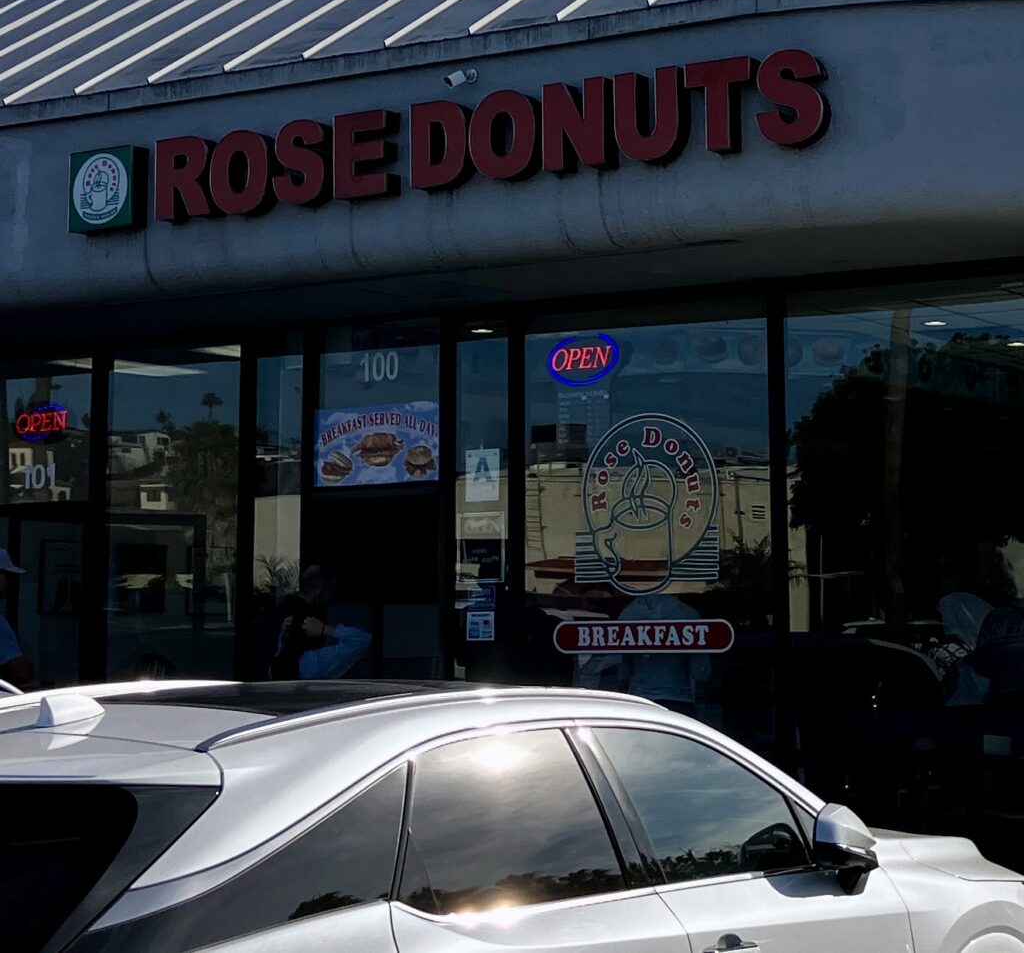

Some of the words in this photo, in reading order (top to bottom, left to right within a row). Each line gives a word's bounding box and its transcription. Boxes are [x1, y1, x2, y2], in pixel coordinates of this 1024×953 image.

[155, 109, 390, 221] ROSE
[411, 49, 828, 189] DONUTS
[360, 351, 399, 383] 100
[552, 345, 612, 372] OPEN
[16, 410, 68, 434] OPEN
[320, 414, 367, 447] BREAKFAST
[368, 412, 402, 426] SERVED
[24, 463, 56, 489] 101
[473, 457, 494, 482] A
[590, 439, 631, 512] Rose
[641, 426, 701, 529] Donuts
[577, 625, 709, 648] BREAKFAST
